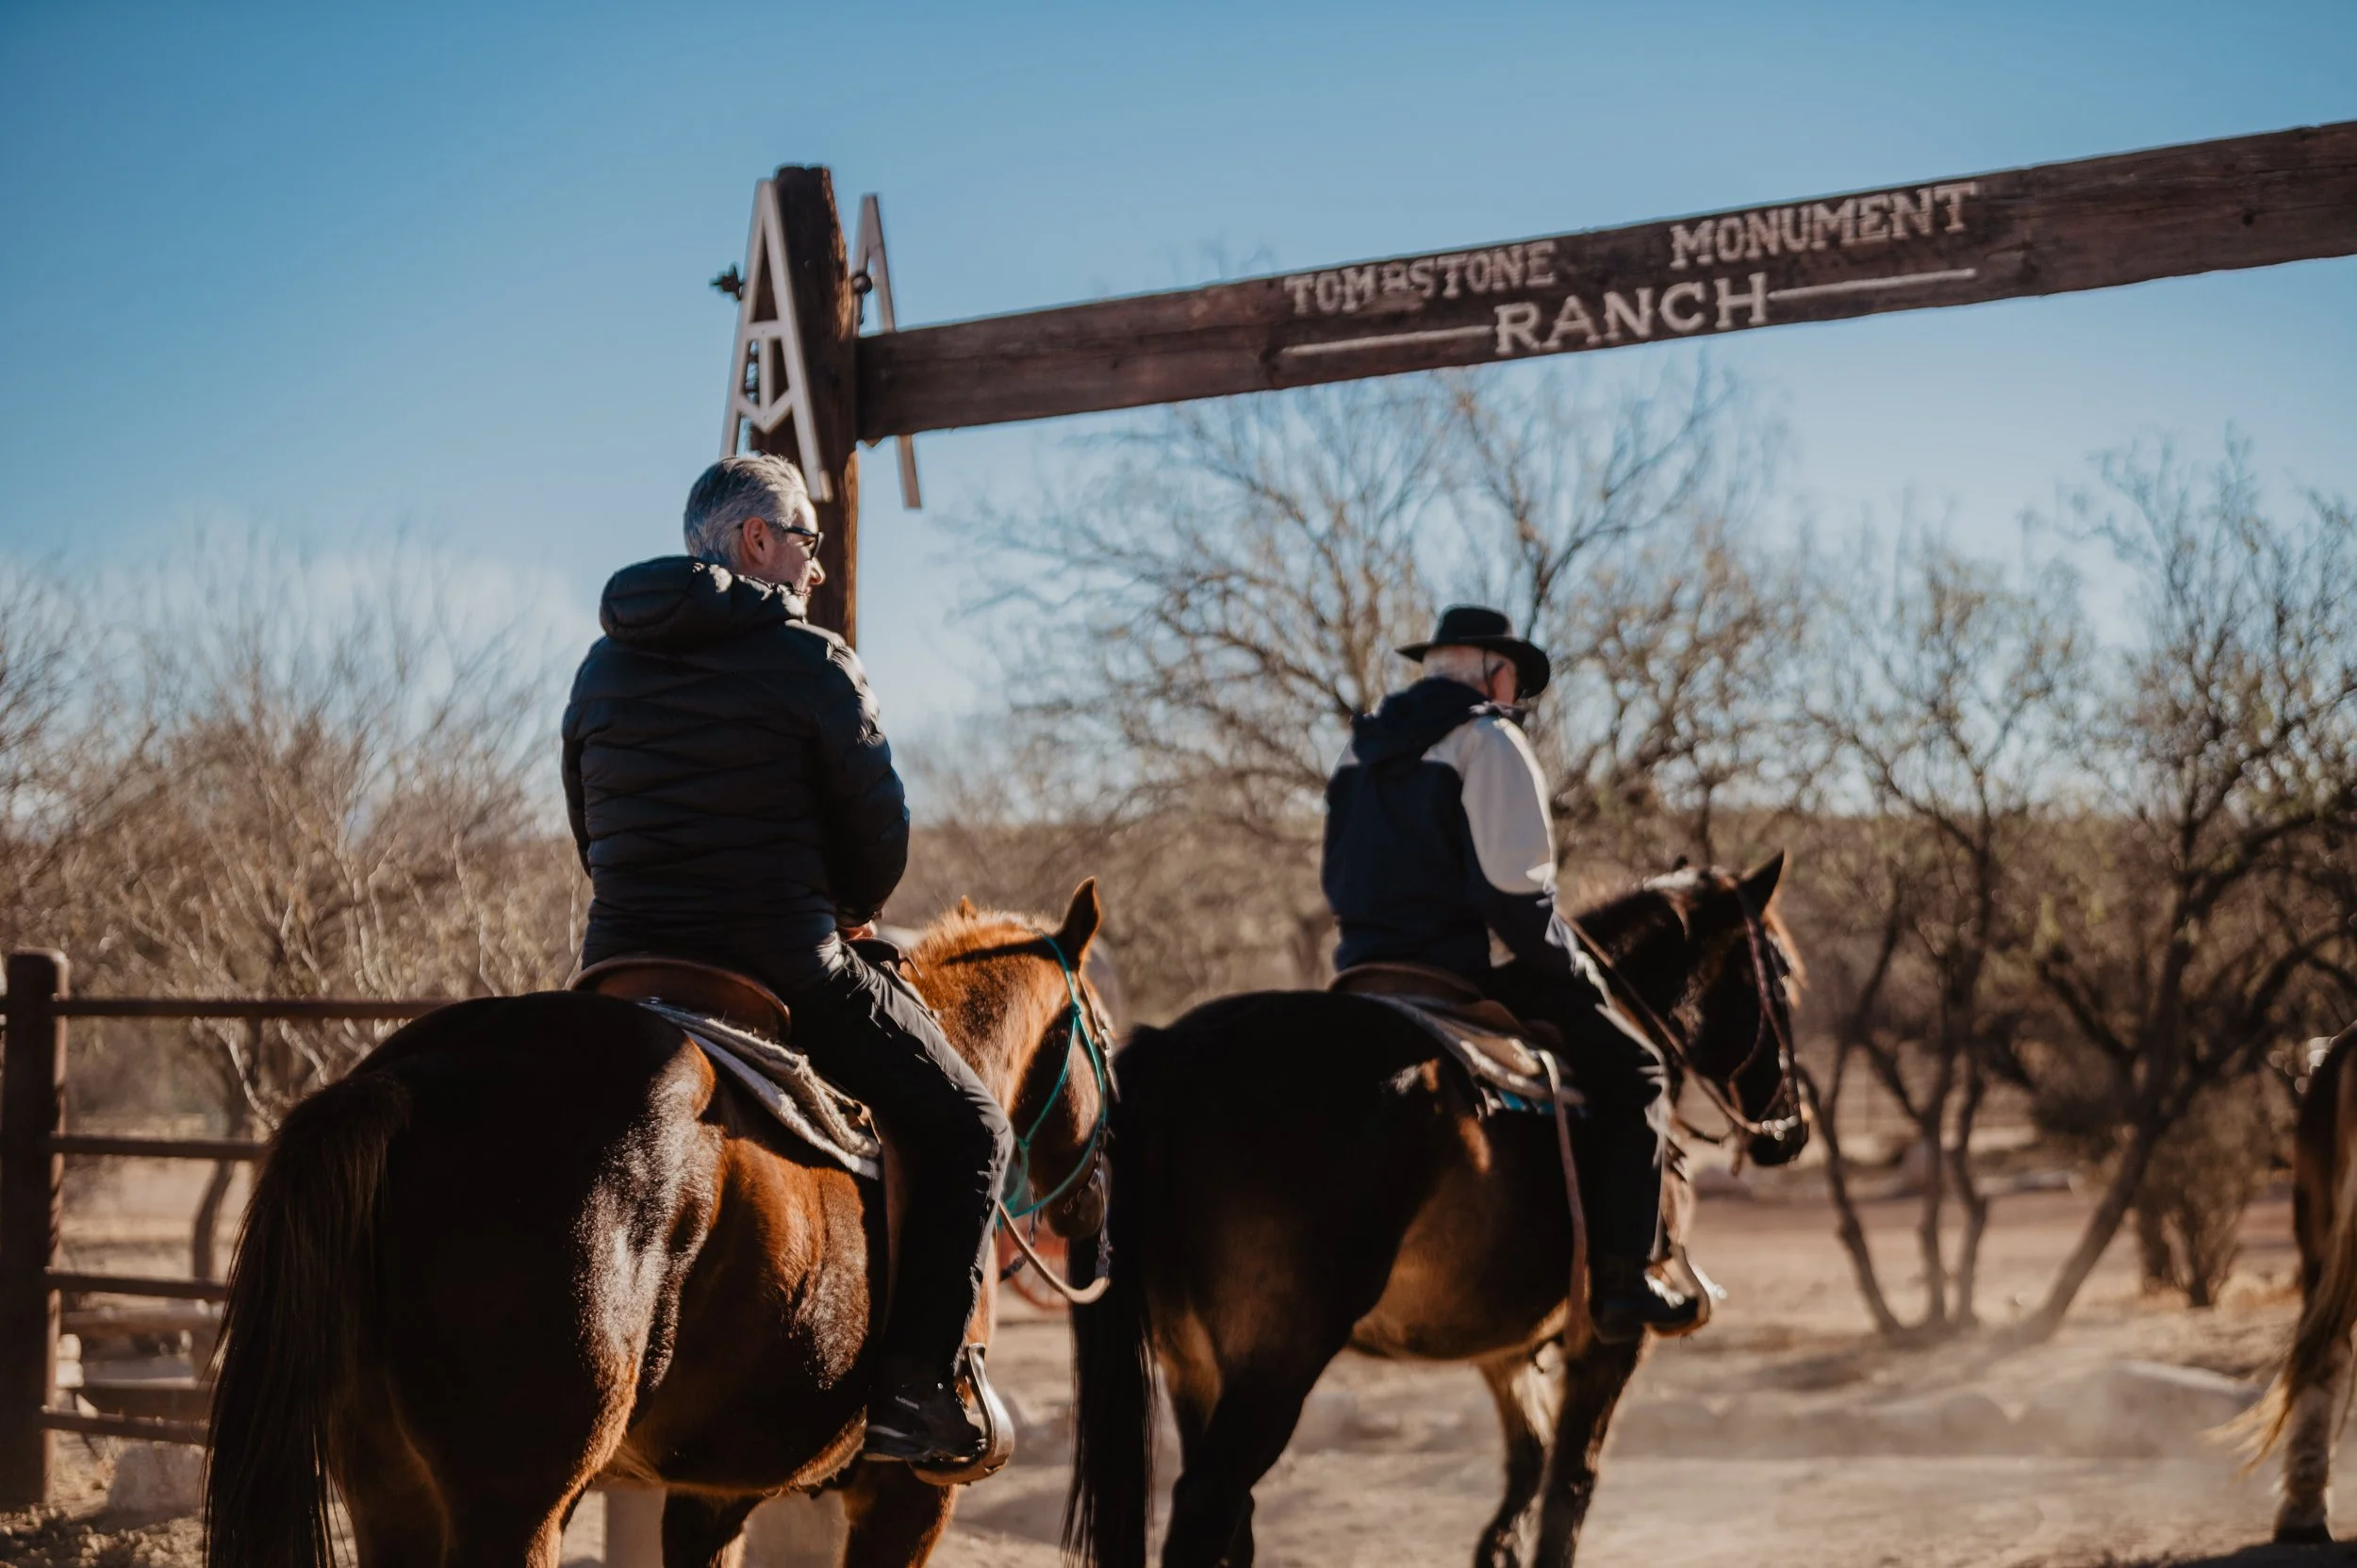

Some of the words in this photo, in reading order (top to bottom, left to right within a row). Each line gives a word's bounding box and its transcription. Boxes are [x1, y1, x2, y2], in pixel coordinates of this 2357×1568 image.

[1284, 240, 1556, 314] TOMBSTONE
[1670, 182, 1977, 270] MONUMENT
[1494, 272, 1768, 355] RANCH
